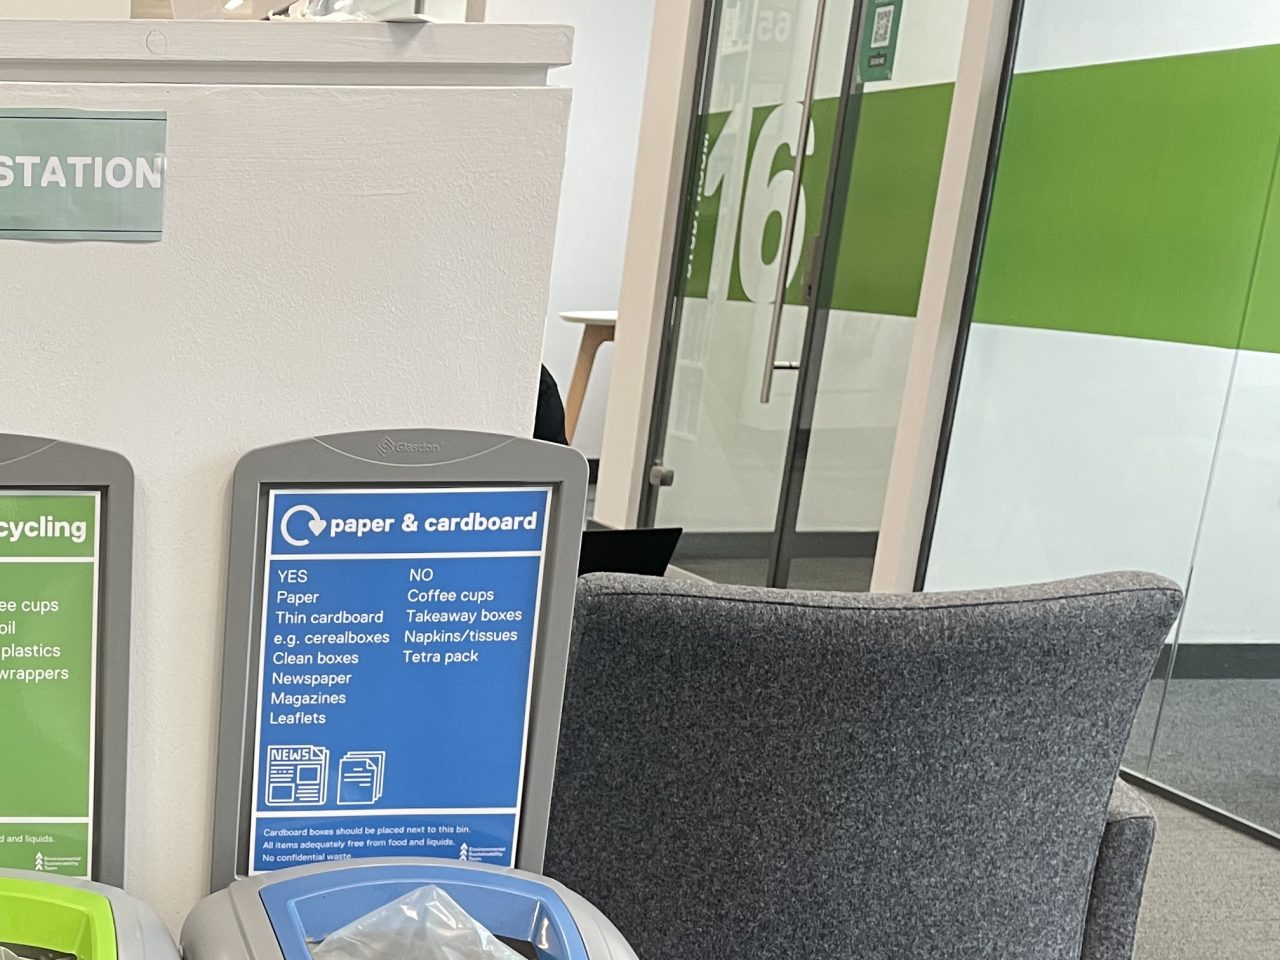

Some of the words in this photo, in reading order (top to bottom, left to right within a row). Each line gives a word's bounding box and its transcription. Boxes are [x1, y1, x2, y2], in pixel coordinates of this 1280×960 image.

[331, 519, 395, 537] paper
[402, 513, 418, 531] &
[425, 511, 537, 531] cardboard
[278, 570, 307, 582] YES
[410, 568, 433, 581] NO
[277, 591, 319, 606] Paper
[408, 589, 456, 602] Coffee
[461, 591, 494, 604] cups
[22, 601, 58, 615] cups
[276, 611, 306, 624] Thin
[311, 610, 383, 623] cardboard
[406, 610, 477, 624] Takeaway
[481, 609, 522, 621] boxes
[274, 635, 299, 647] e.g.
[305, 631, 389, 644] cerealboxes
[405, 630, 517, 645] Napkins/tissues
[2, 644, 60, 660] plastics
[273, 652, 312, 664] Clean
[318, 652, 358, 664] boxes
[403, 650, 440, 662] Tetra
[445, 650, 478, 665] pack
[272, 672, 352, 687] Newspaper
[271, 692, 346, 707] Magazines
[270, 712, 326, 724] Leaflets
[271, 749, 309, 761] NEWS
[263, 828, 307, 837] Cardboard
[309, 828, 334, 836] boxes
[335, 827, 363, 836] should
[364, 827, 375, 835] be
[376, 826, 404, 837] placed
[406, 826, 425, 834] next
[426, 826, 436, 834] to
[438, 826, 455, 834] this
[456, 825, 471, 834] bin.
[6, 834, 23, 843] and
[25, 834, 55, 845] liquids.
[262, 841, 274, 849] All
[275, 840, 299, 849] items
[300, 839, 345, 850] adequately
[347, 839, 365, 847] free
[366, 839, 386, 847] from
[409, 838, 425, 846] and
[426, 838, 455, 847] liquids.
[262, 853, 275, 861] No
[276, 853, 325, 861] confidential
